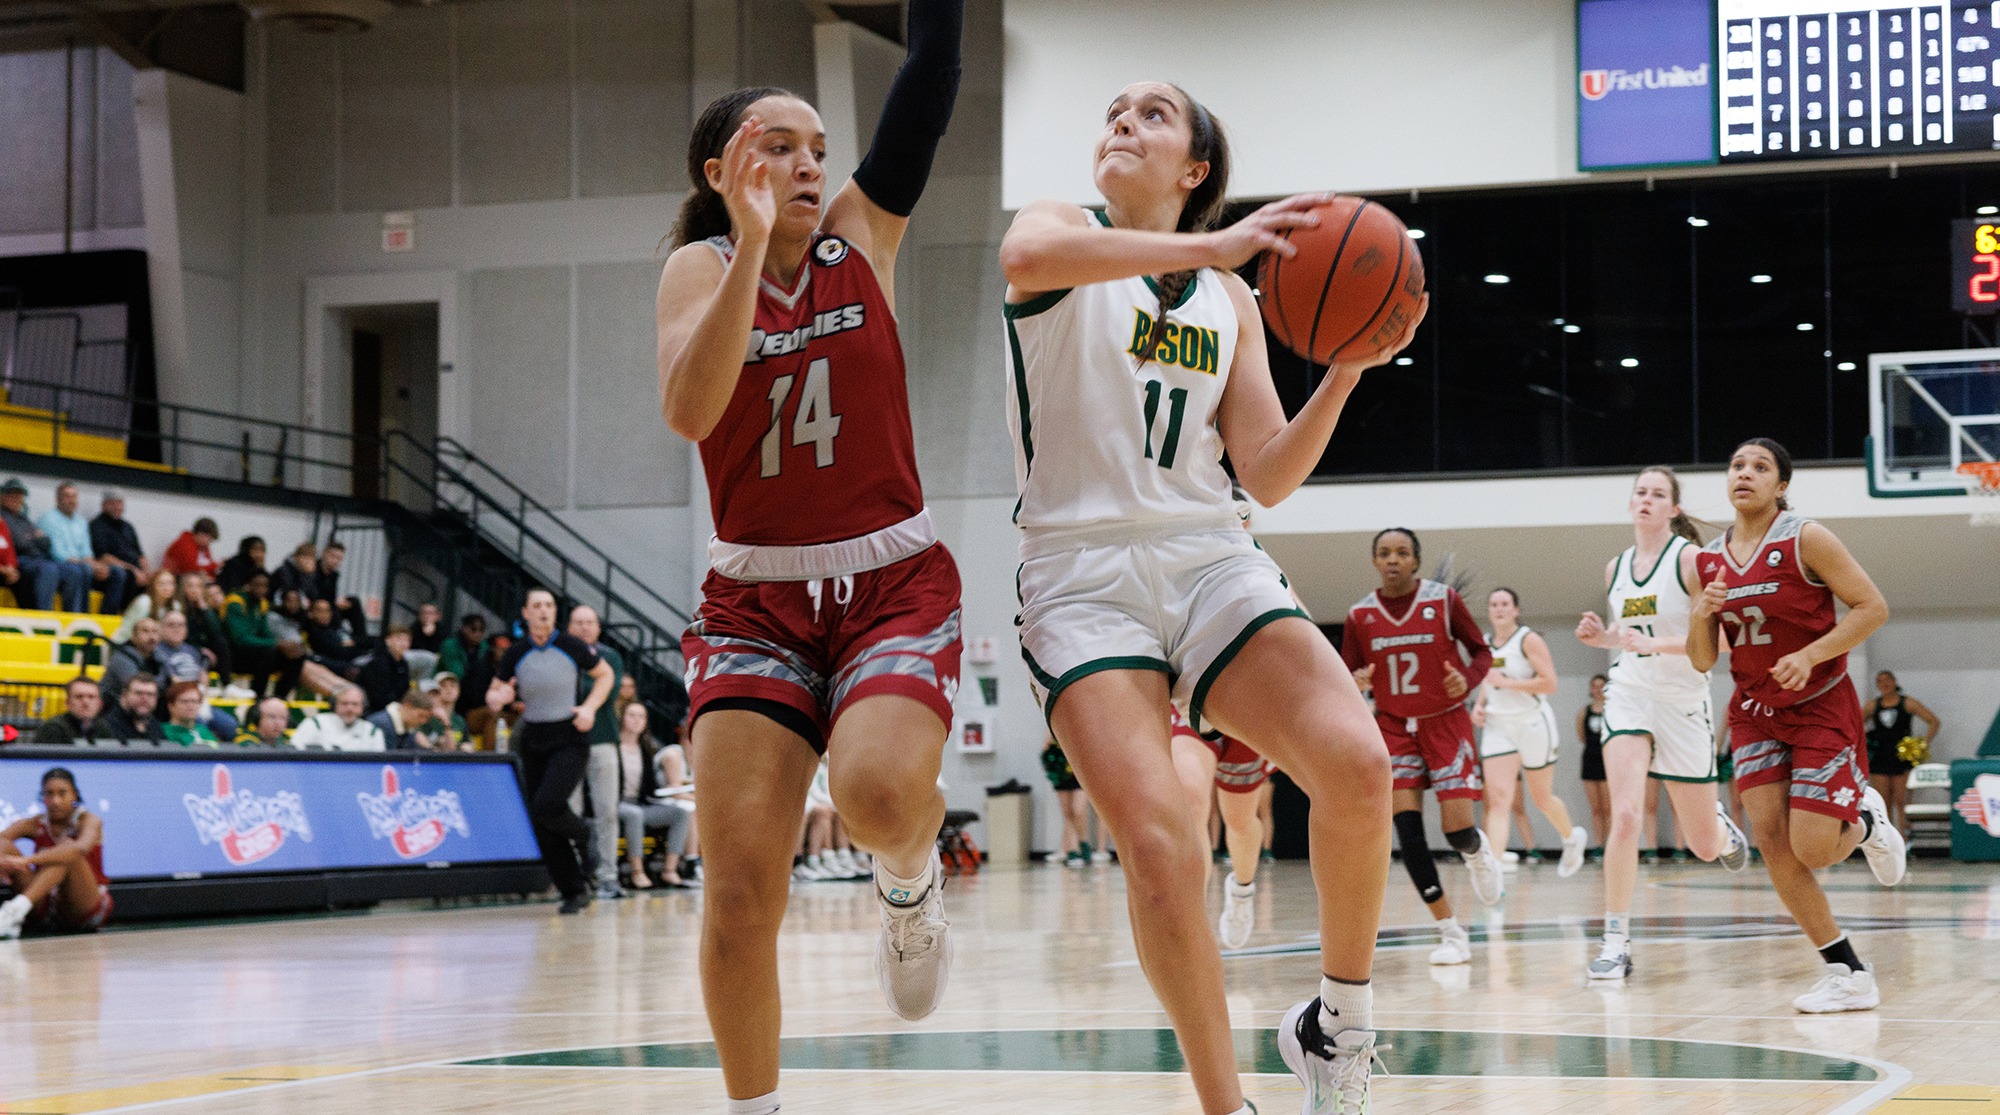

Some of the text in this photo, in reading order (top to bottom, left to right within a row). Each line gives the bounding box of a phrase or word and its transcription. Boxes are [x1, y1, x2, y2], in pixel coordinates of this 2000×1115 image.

[760, 356, 842, 479] 14
[1144, 379, 1188, 470] 11
[1386, 651, 1420, 696] 12
